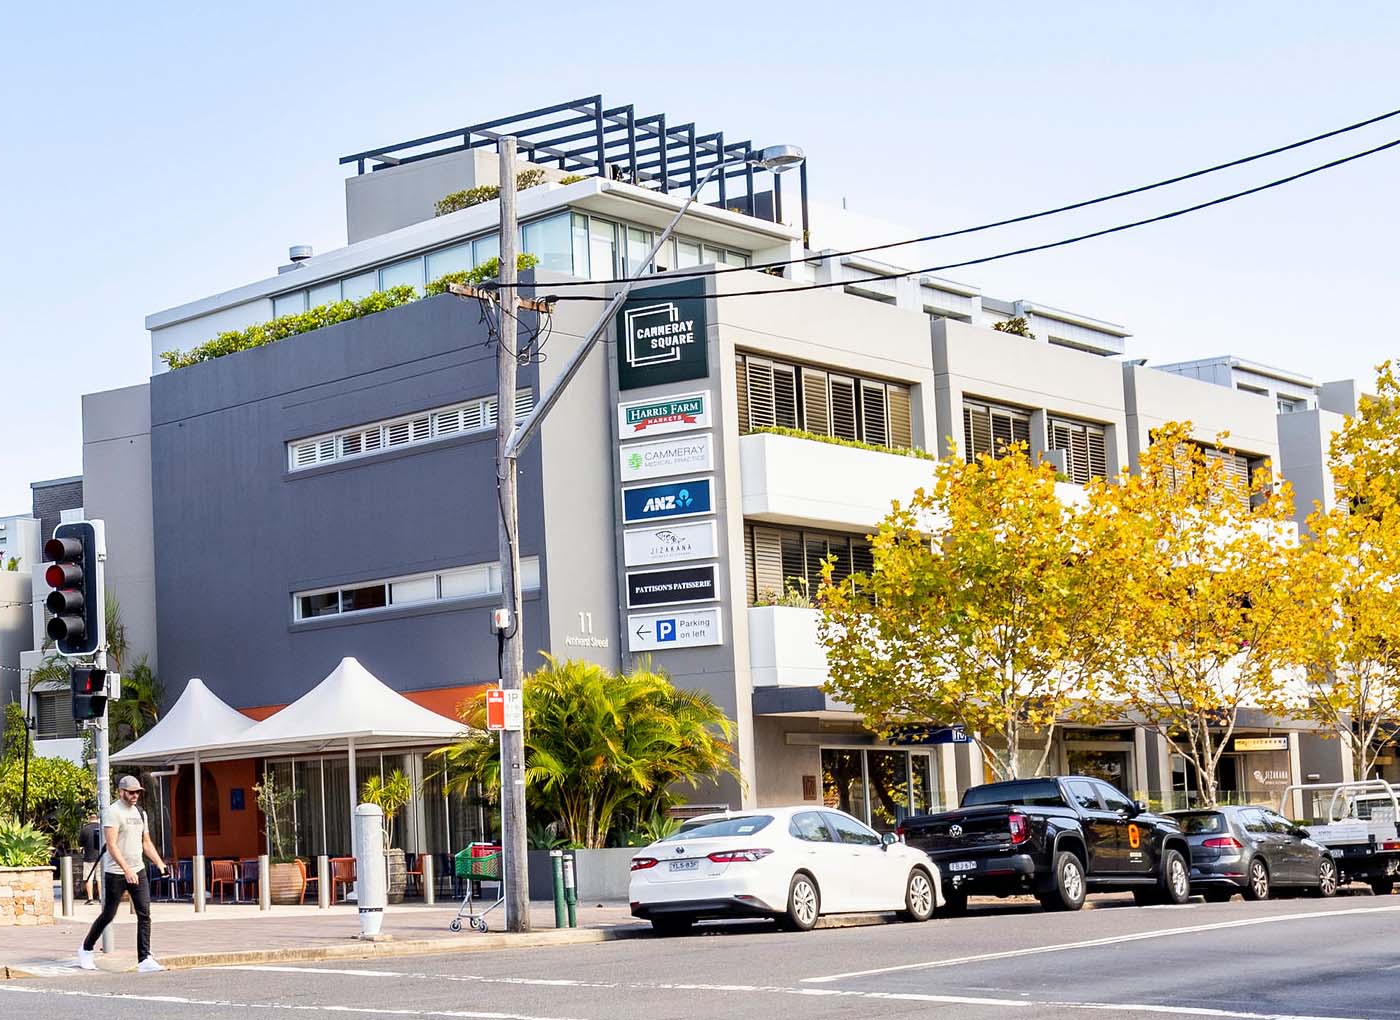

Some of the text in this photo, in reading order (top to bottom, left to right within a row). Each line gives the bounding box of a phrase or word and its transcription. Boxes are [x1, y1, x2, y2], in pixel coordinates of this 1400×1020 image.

[636, 320, 694, 340] CAMMERAY
[650, 333, 695, 349] SQUARE
[631, 402, 699, 421] HARRIS FARM
[644, 445, 705, 461] CAMMERAY
[642, 495, 676, 513] ANZ
[650, 543, 693, 555] JIZAKANA
[635, 580, 712, 594] PATTISON'S PATISSERIE
[578, 611, 593, 633] 11
[660, 619, 711, 640] P Parking
[680, 629, 706, 639] on left
